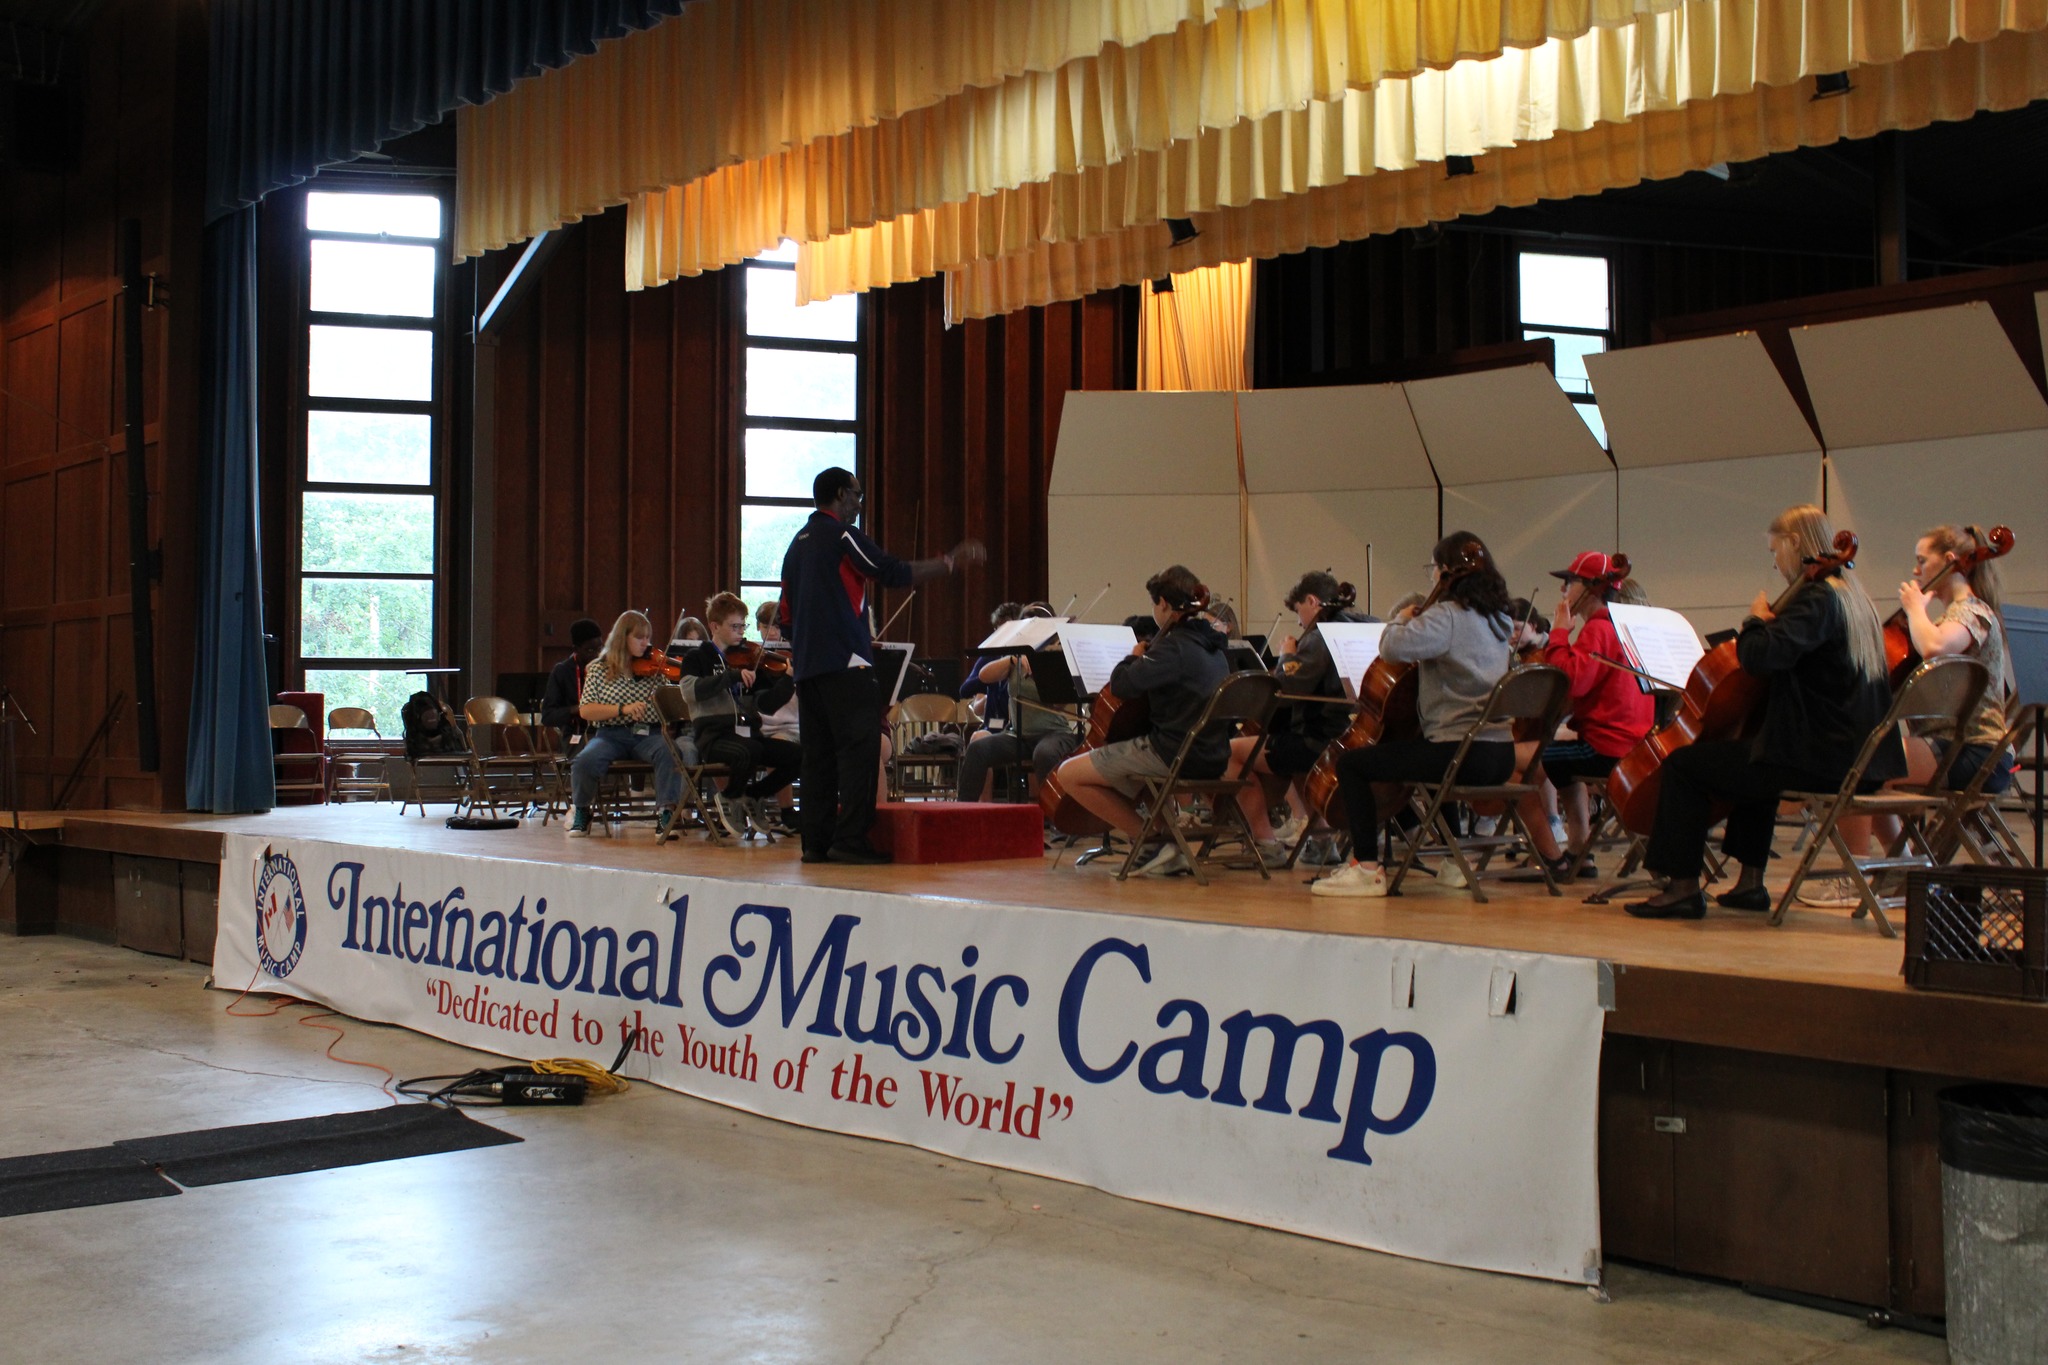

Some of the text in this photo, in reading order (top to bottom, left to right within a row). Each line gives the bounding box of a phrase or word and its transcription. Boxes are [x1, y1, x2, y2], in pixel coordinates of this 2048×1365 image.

[257, 857, 305, 919] INTERNATIONAL
[257, 934, 301, 977] MUSIC CAMP
[327, 861, 1436, 1165] International Music Camp
[426, 978, 1074, 1140] “Dedicated to the Youth of the World”
